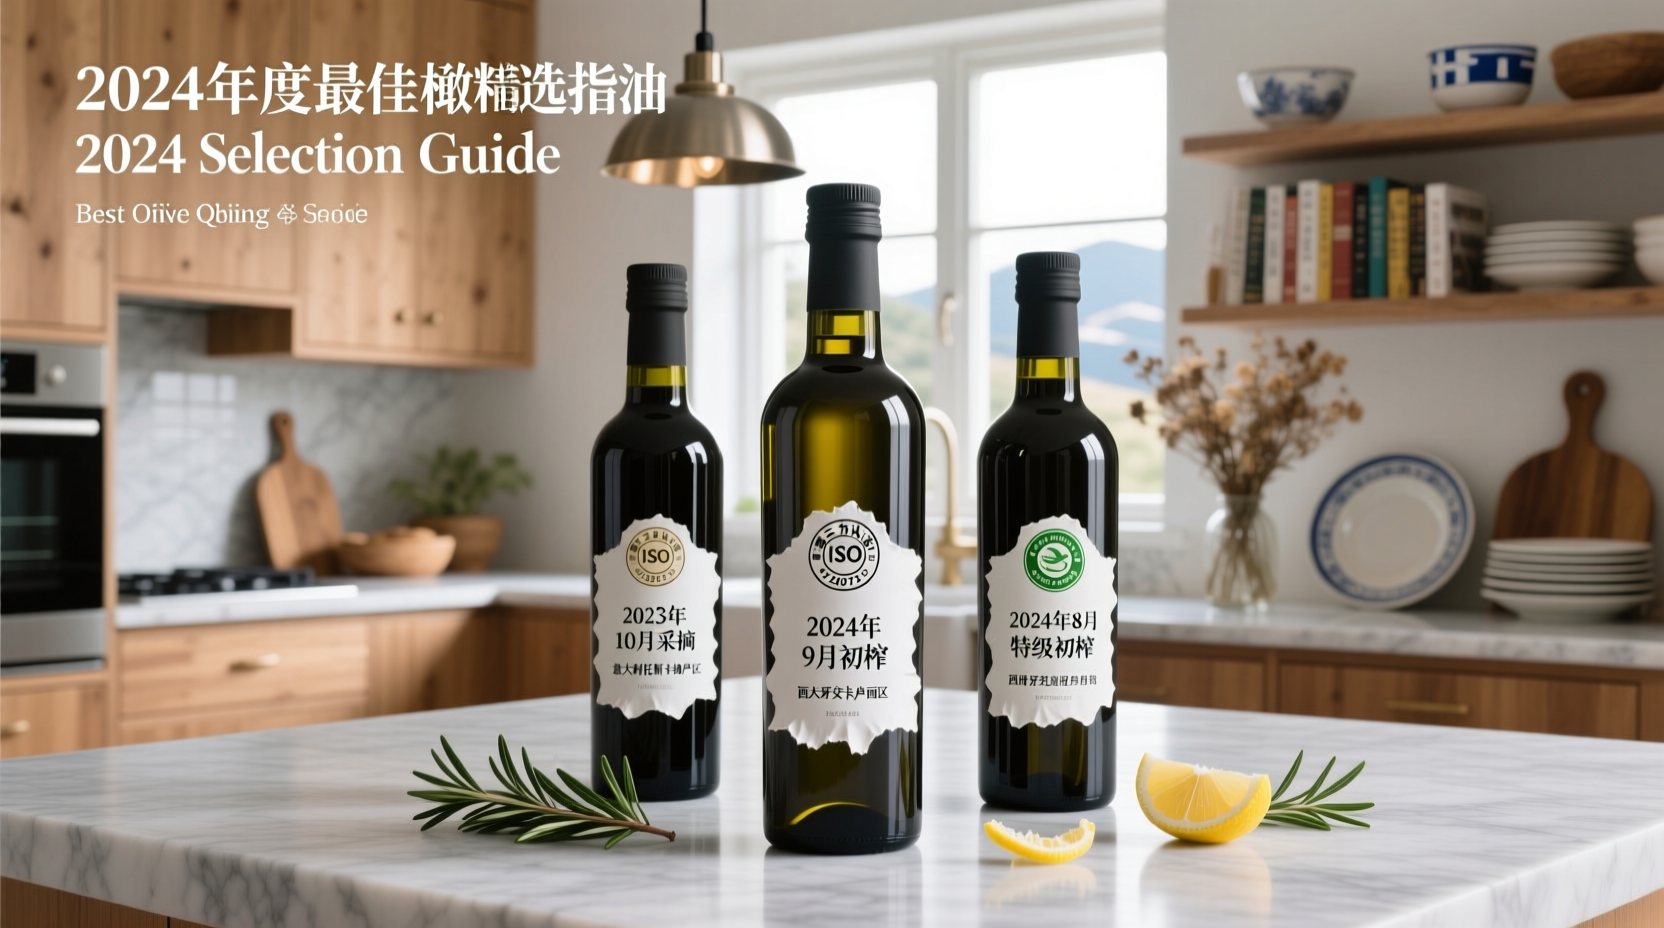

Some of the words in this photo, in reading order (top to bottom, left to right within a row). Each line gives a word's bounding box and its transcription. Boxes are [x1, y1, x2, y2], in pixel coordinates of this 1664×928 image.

[642, 548, 670, 564] ISO
[828, 545, 863, 563] ISO
[622, 605, 687, 626] 2023年
[1009, 609, 1097, 631] 2024年8月
[806, 613, 882, 640] 2024年
[801, 642, 889, 671] 9月初榨
